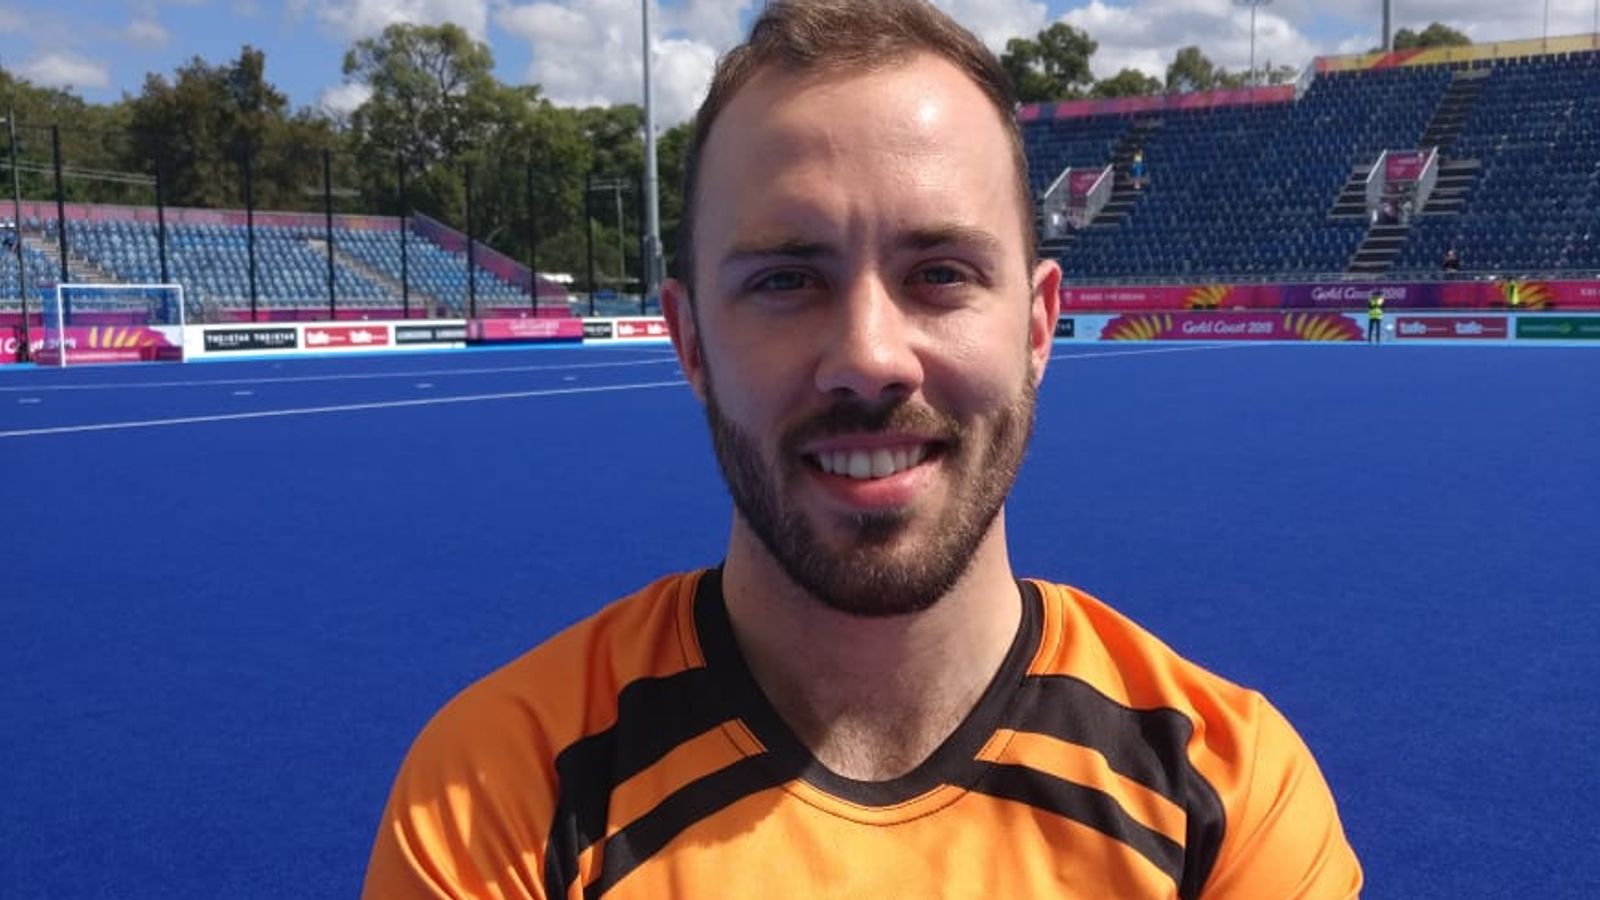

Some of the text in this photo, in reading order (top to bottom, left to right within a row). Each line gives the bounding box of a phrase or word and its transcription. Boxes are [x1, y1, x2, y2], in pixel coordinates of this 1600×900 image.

[1311, 286, 1342, 300] Gold
[1182, 320, 1273, 334] Gold Coast 2018
